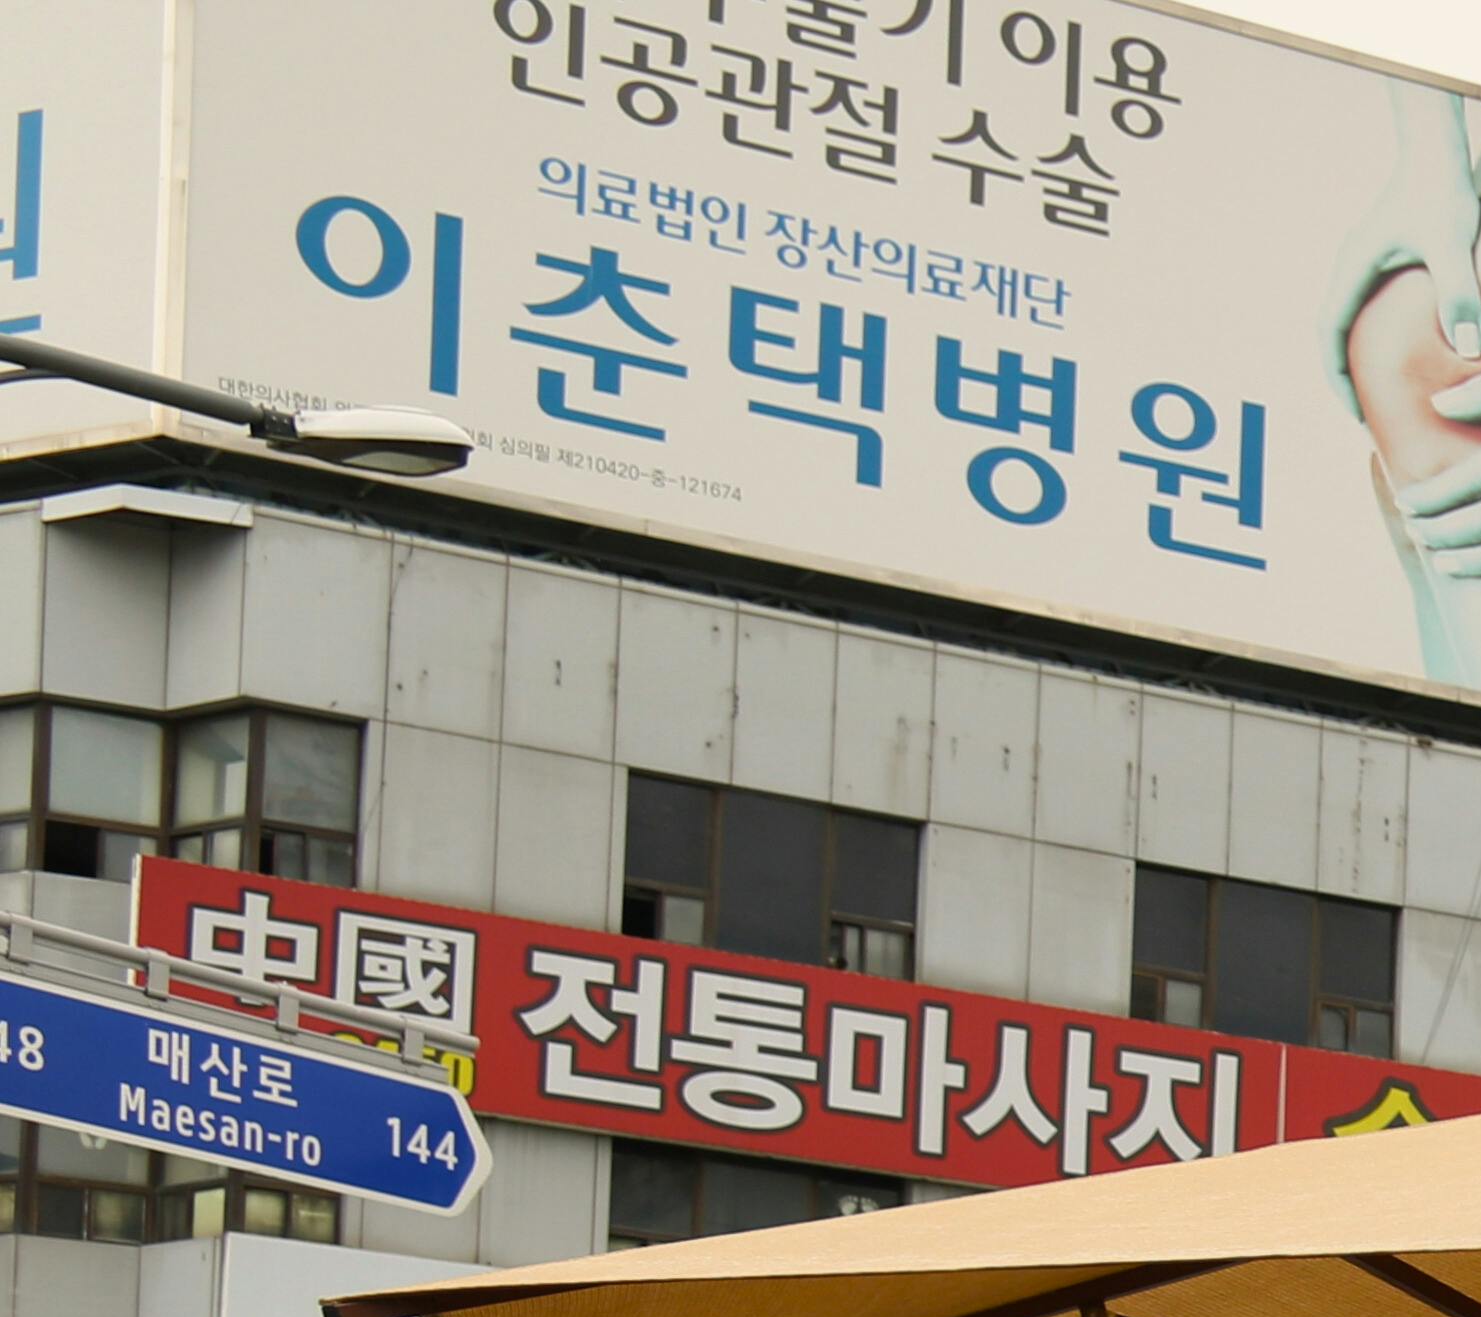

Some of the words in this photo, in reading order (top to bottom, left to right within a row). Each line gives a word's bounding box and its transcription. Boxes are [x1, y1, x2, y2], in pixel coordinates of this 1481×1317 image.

[492, 0, 899, 184] 인공관절
[930, 108, 1121, 238] 수술
[1000, 10, 1183, 140] 이용
[537, 156, 748, 255] 의료법인
[765, 210, 1072, 330] 장산의료재단
[295, 194, 1268, 571] 이춘택병원
[499, 433, 552, 465] 심의필
[147, 1028, 299, 1108] 매산로
[188, 890, 478, 1037] 中國
[518, 948, 1240, 1178] 전통마사지
[119, 1083, 323, 1167] Maesan-ro
[386, 1116, 459, 1171] 144
